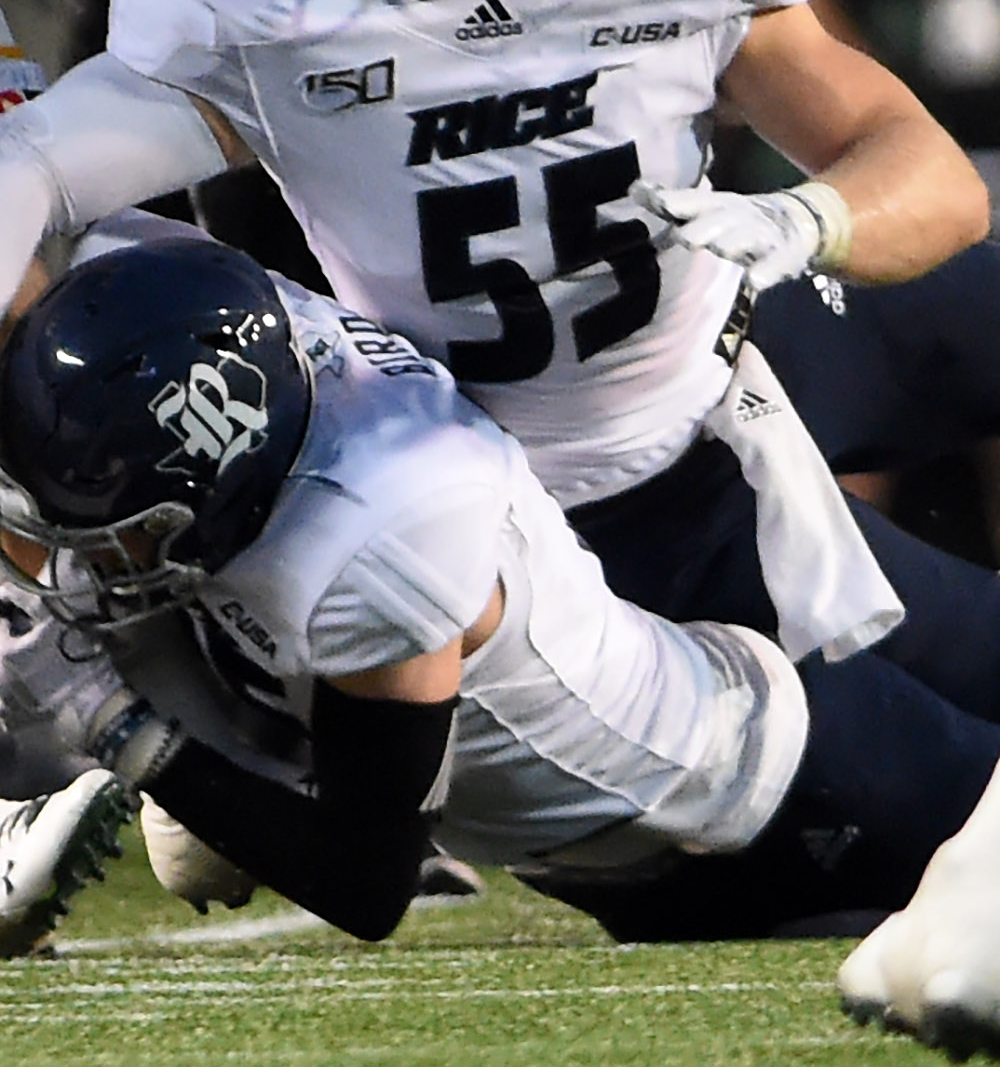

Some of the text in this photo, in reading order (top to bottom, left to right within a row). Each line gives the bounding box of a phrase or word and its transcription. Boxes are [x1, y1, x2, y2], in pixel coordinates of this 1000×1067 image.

[455, 21, 524, 41] adidas
[302, 56, 395, 112] 150
[405, 69, 599, 167] RICE
[416, 140, 661, 383] 55
